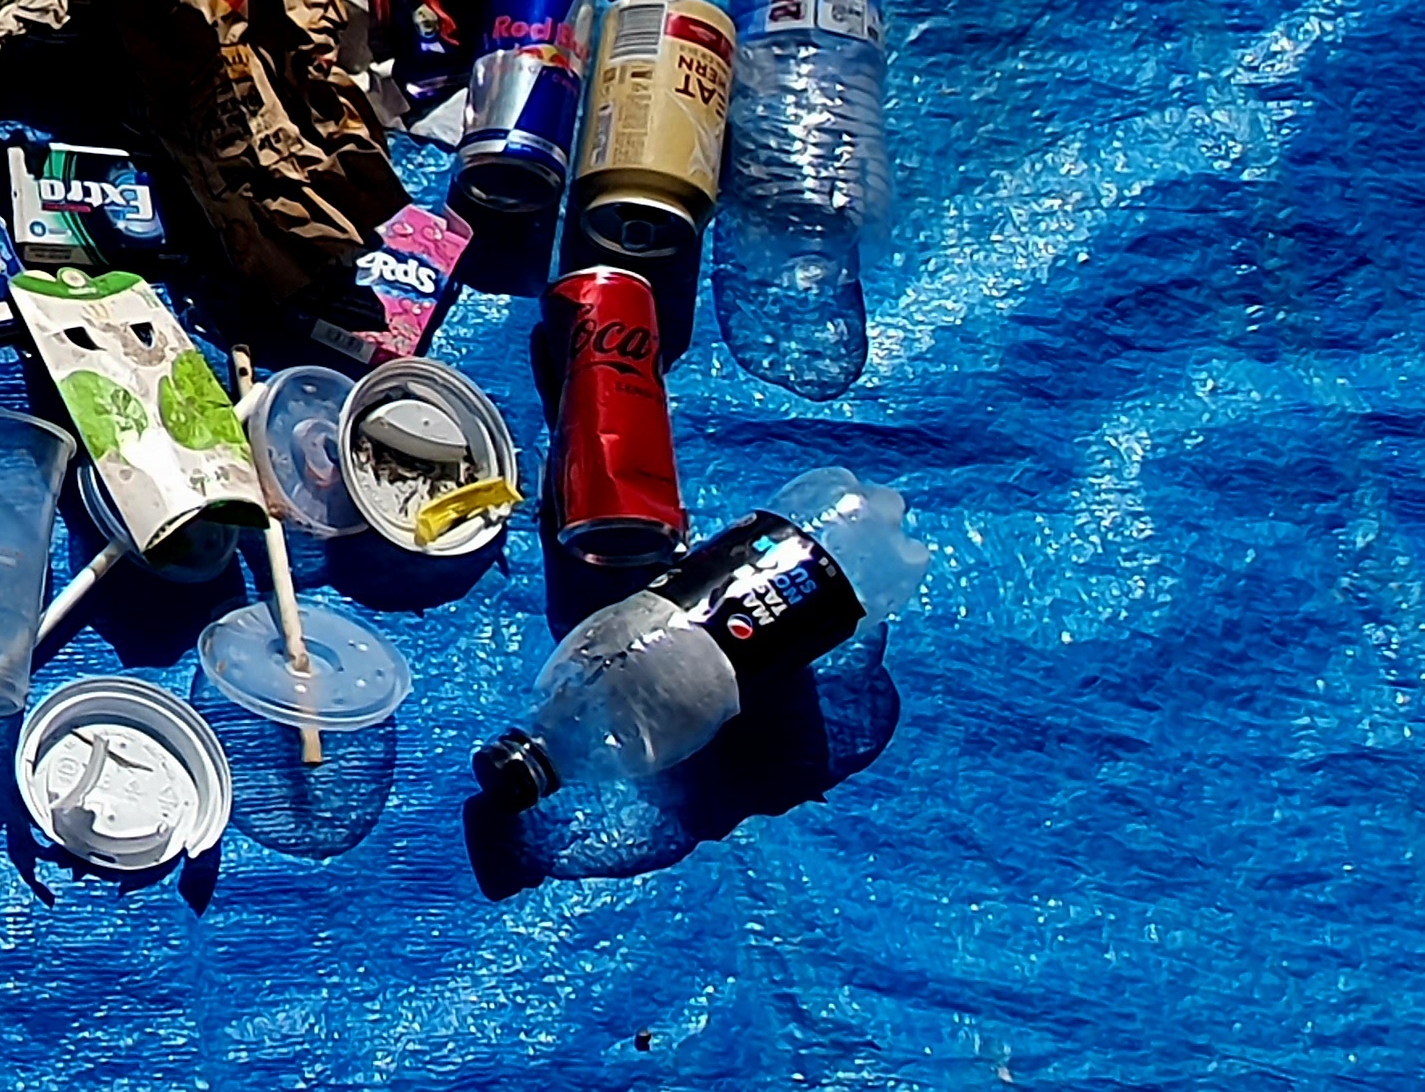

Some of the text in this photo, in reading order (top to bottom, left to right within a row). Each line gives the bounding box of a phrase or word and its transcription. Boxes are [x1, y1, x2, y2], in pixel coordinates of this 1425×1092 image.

[492, 14, 552, 40] Red
[38, 178, 154, 221] Extra
[774, 573, 804, 605] NO
